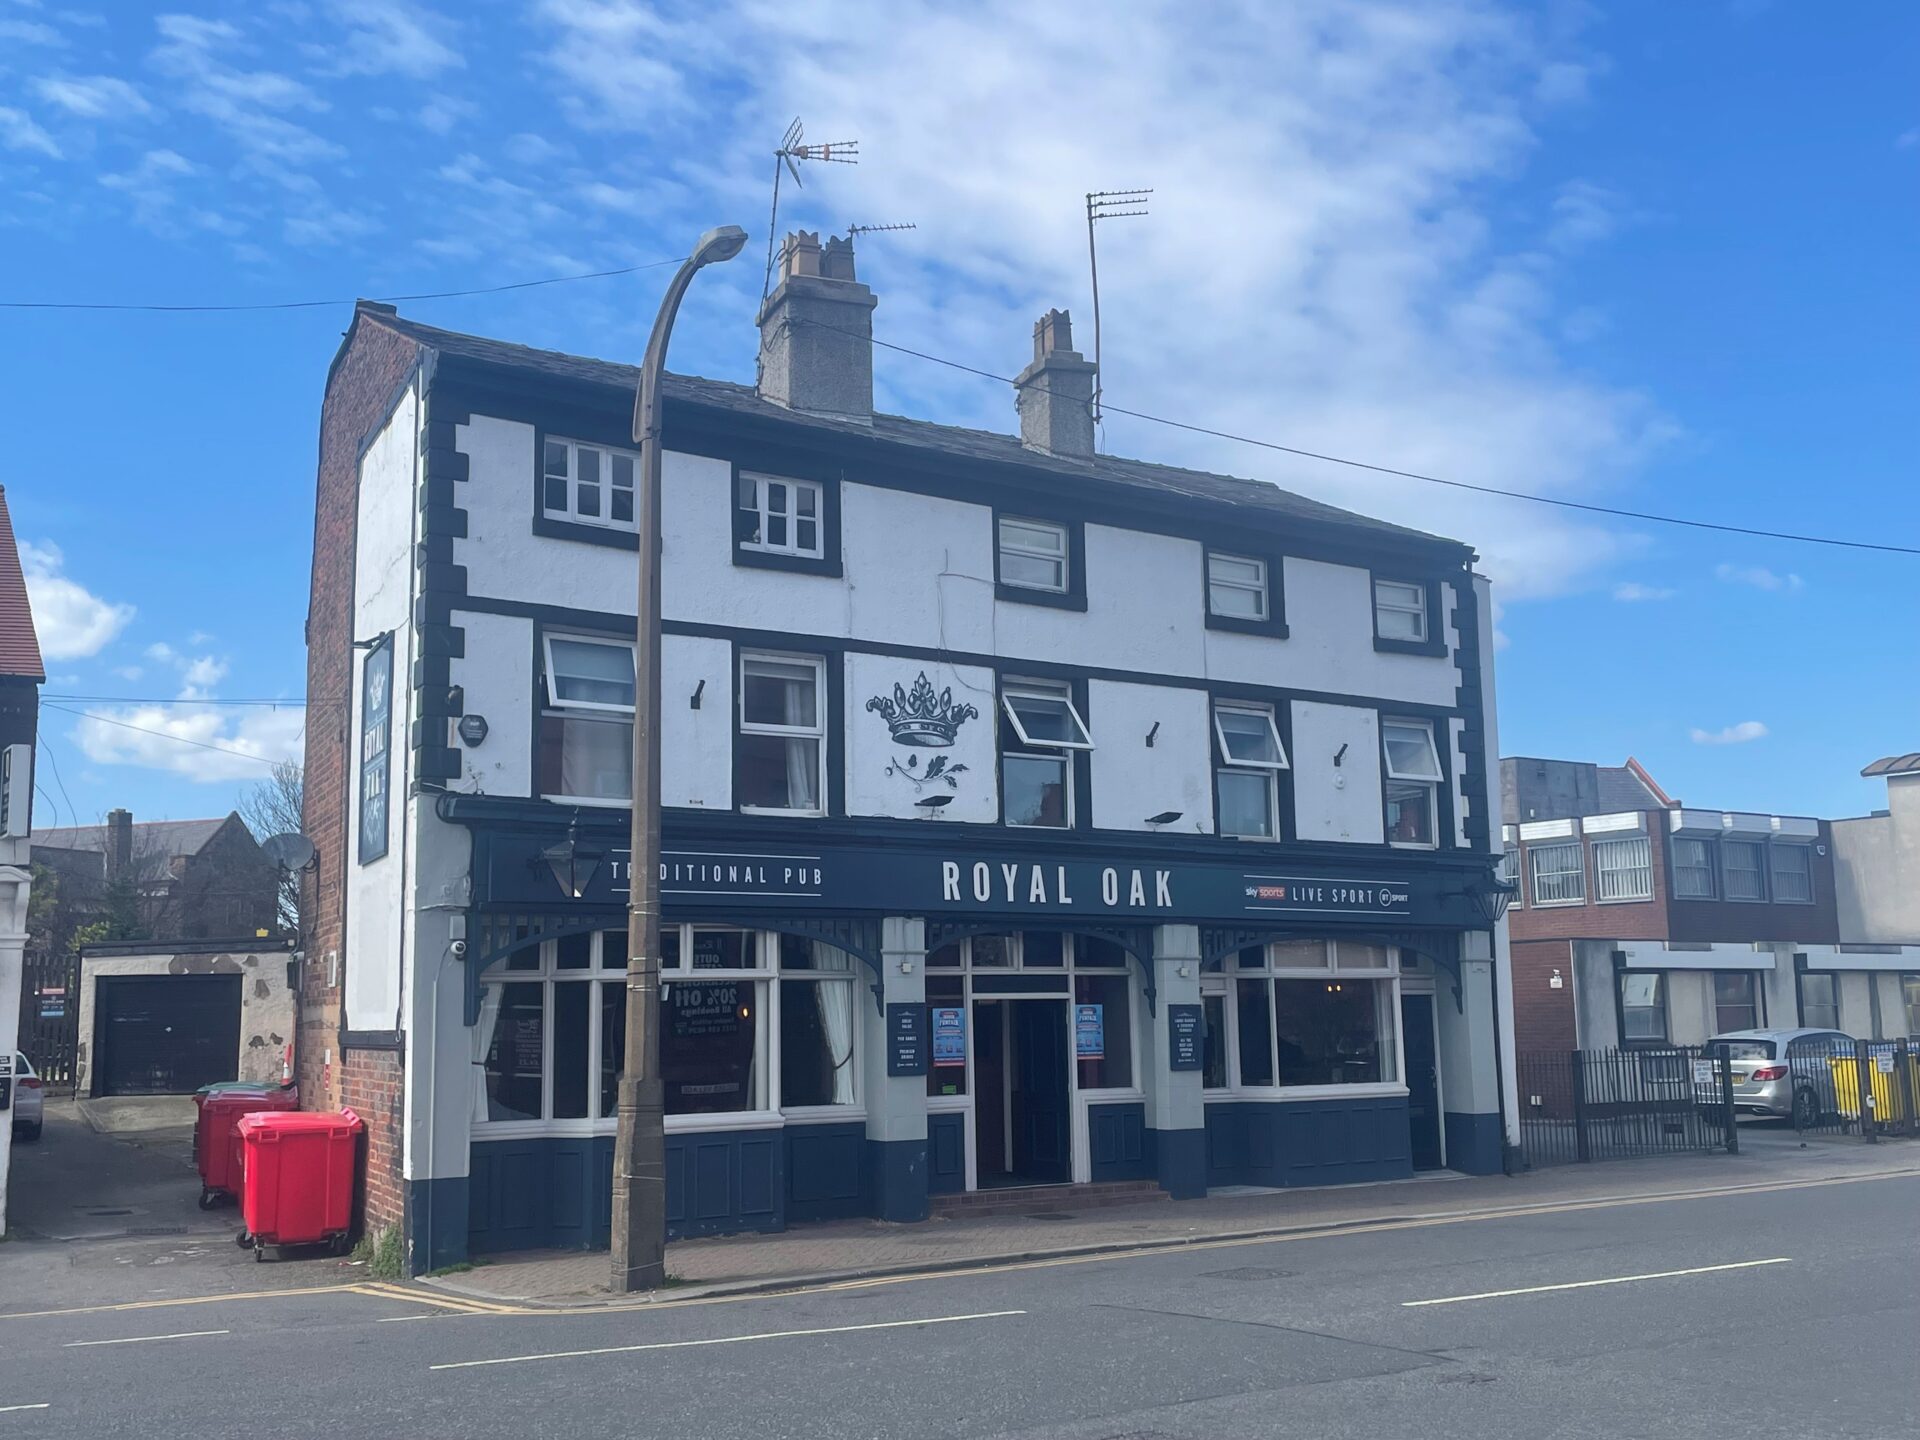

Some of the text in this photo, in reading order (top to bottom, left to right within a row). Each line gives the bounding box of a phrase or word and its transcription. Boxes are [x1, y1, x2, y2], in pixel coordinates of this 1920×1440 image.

[611, 861, 822, 885] TRDITIONAL PUB
[942, 861, 1173, 907] ROYAL OAK
[1245, 886, 1285, 899] sky sports
[1292, 887, 1373, 904] LIVE SPORT
[1391, 894, 1409, 902] SPORT
